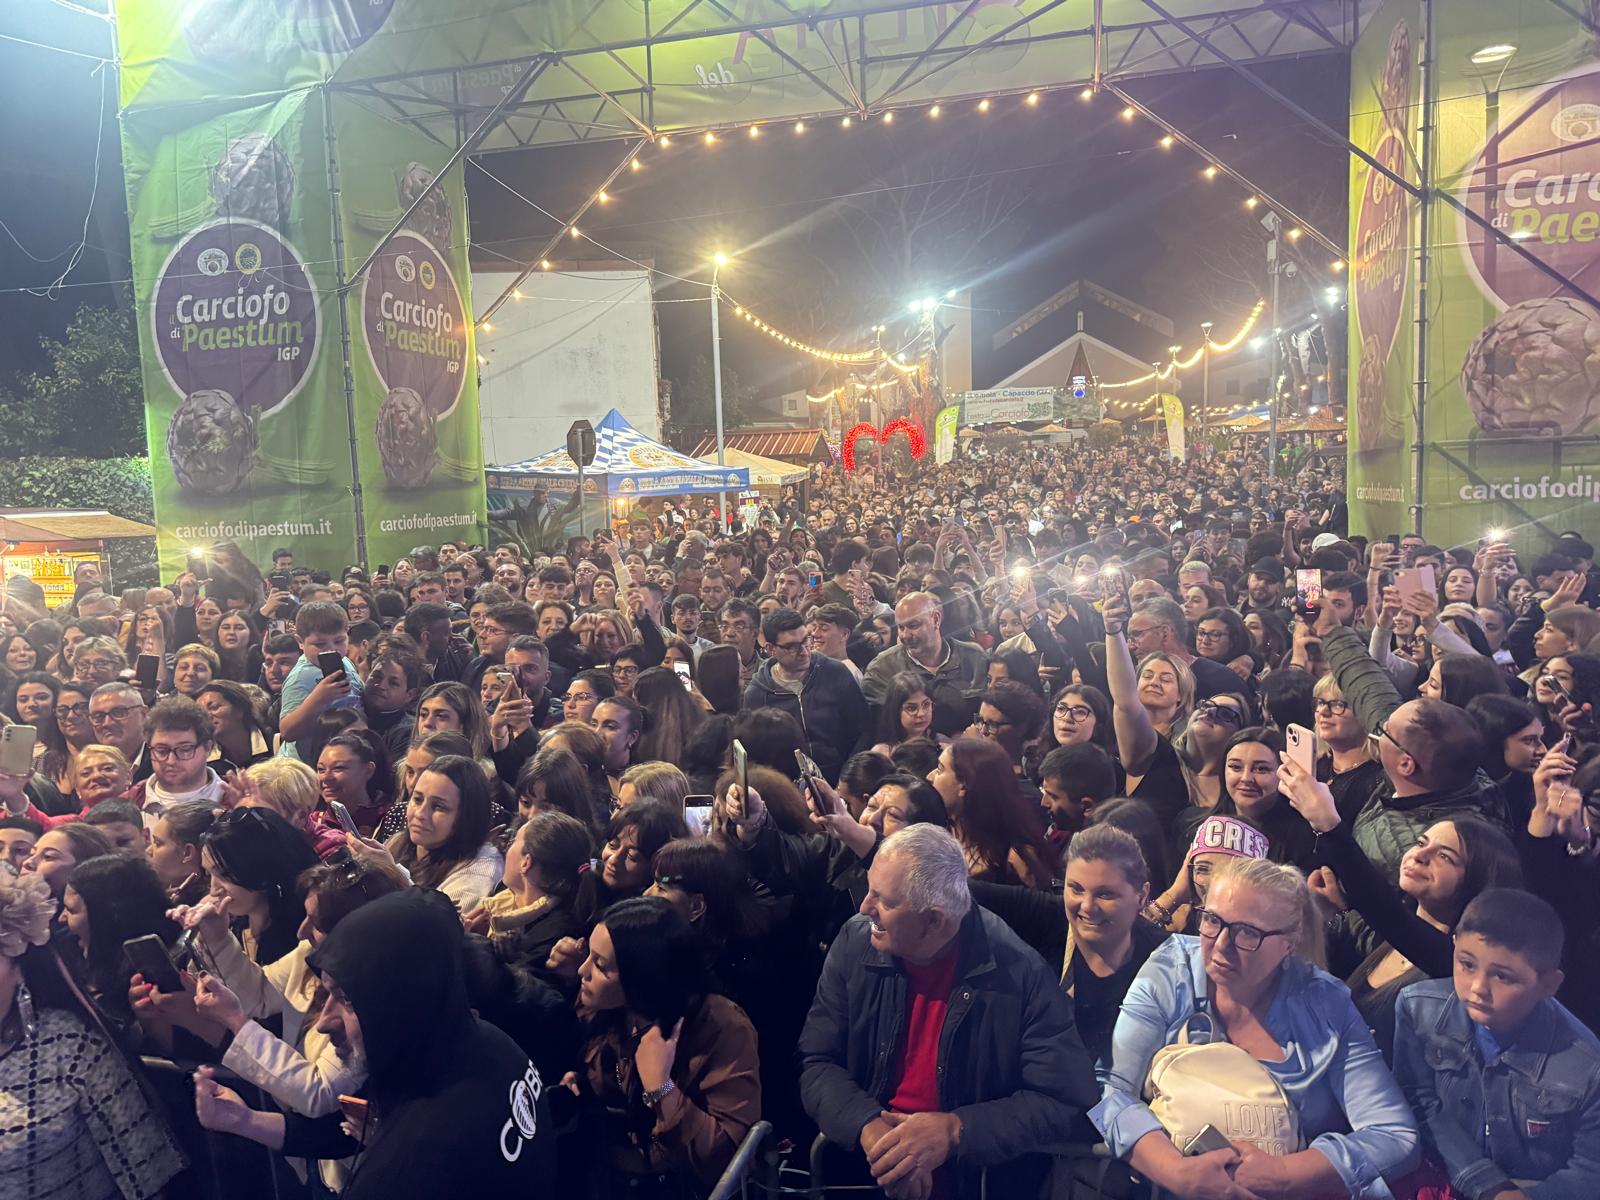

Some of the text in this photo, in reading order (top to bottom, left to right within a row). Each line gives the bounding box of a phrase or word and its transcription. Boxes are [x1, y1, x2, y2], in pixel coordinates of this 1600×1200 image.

[1491, 212, 1509, 228] di
[176, 284, 290, 324] Carciofo
[380, 292, 452, 335] Carciofo
[170, 318, 304, 352] di Paestum
[376, 319, 461, 360] di Paestum
[277, 346, 300, 361] IGP
[446, 360, 460, 374] IGP
[175, 519, 332, 540] carciofodipaestum.it
[380, 513, 478, 532] carciofodipaestum.it
[1205, 820, 1269, 860] CRES
[1224, 1103, 1283, 1138] LOVE
